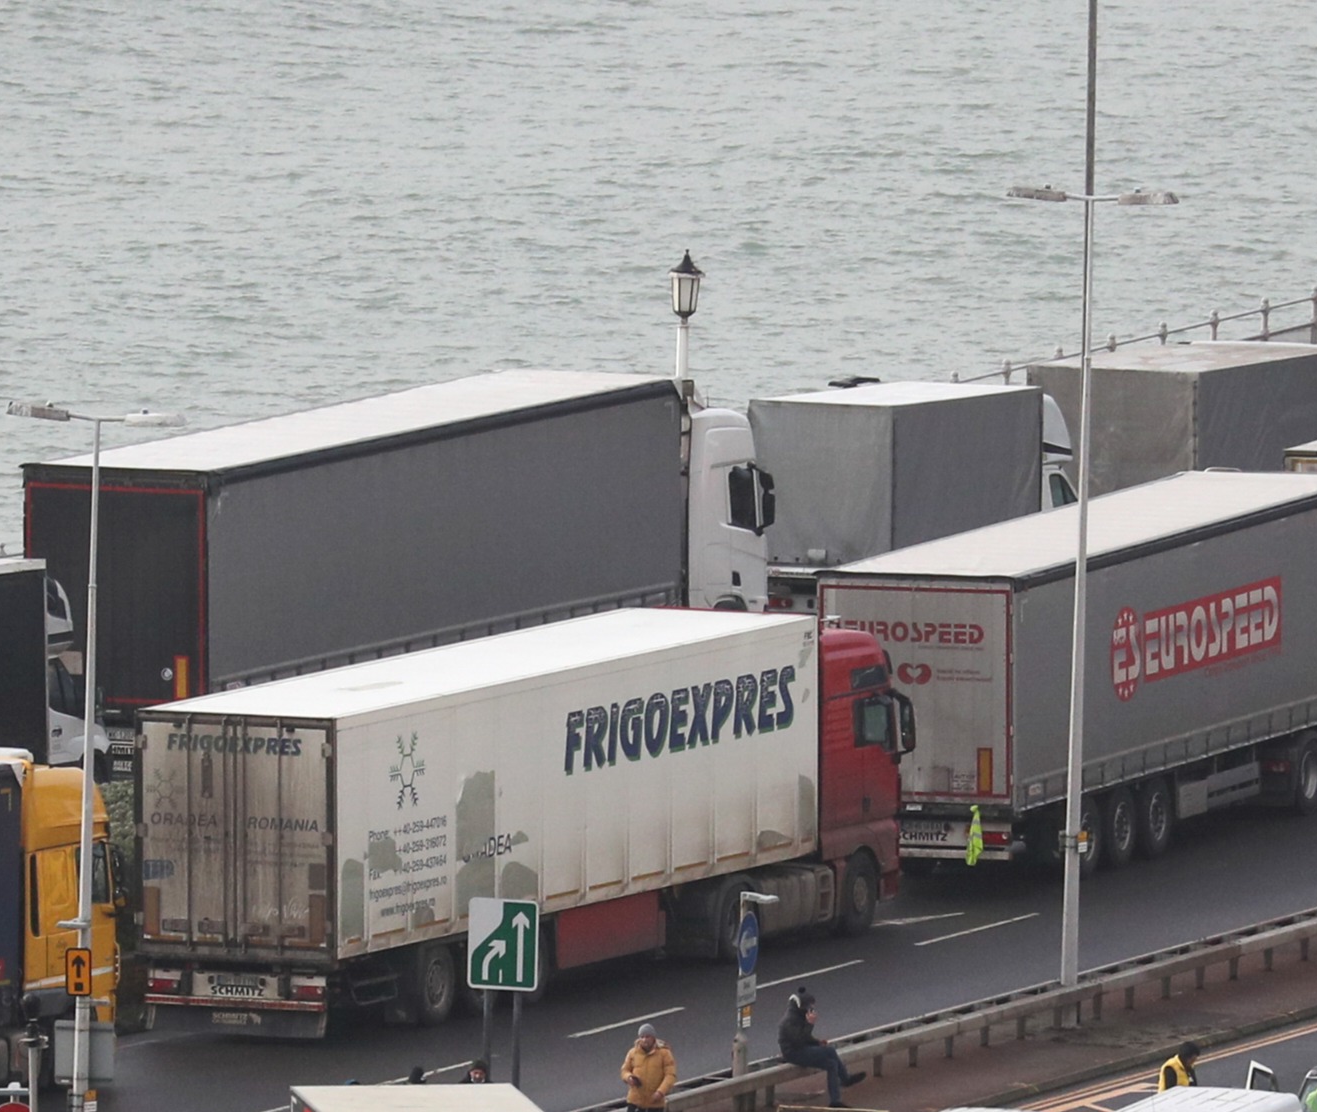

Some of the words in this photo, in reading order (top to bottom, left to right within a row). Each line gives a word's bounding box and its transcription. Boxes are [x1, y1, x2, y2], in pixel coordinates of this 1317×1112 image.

[1145, 585, 1279, 676] EUROSPEED
[564, 665, 797, 776] FRIGOEXPRES
[167, 733, 302, 756] FRIGOEXPRES
[151, 812, 217, 827] ORADEA
[247, 816, 319, 832] ROMANIA
[210, 985, 264, 997] SCHMITZ
